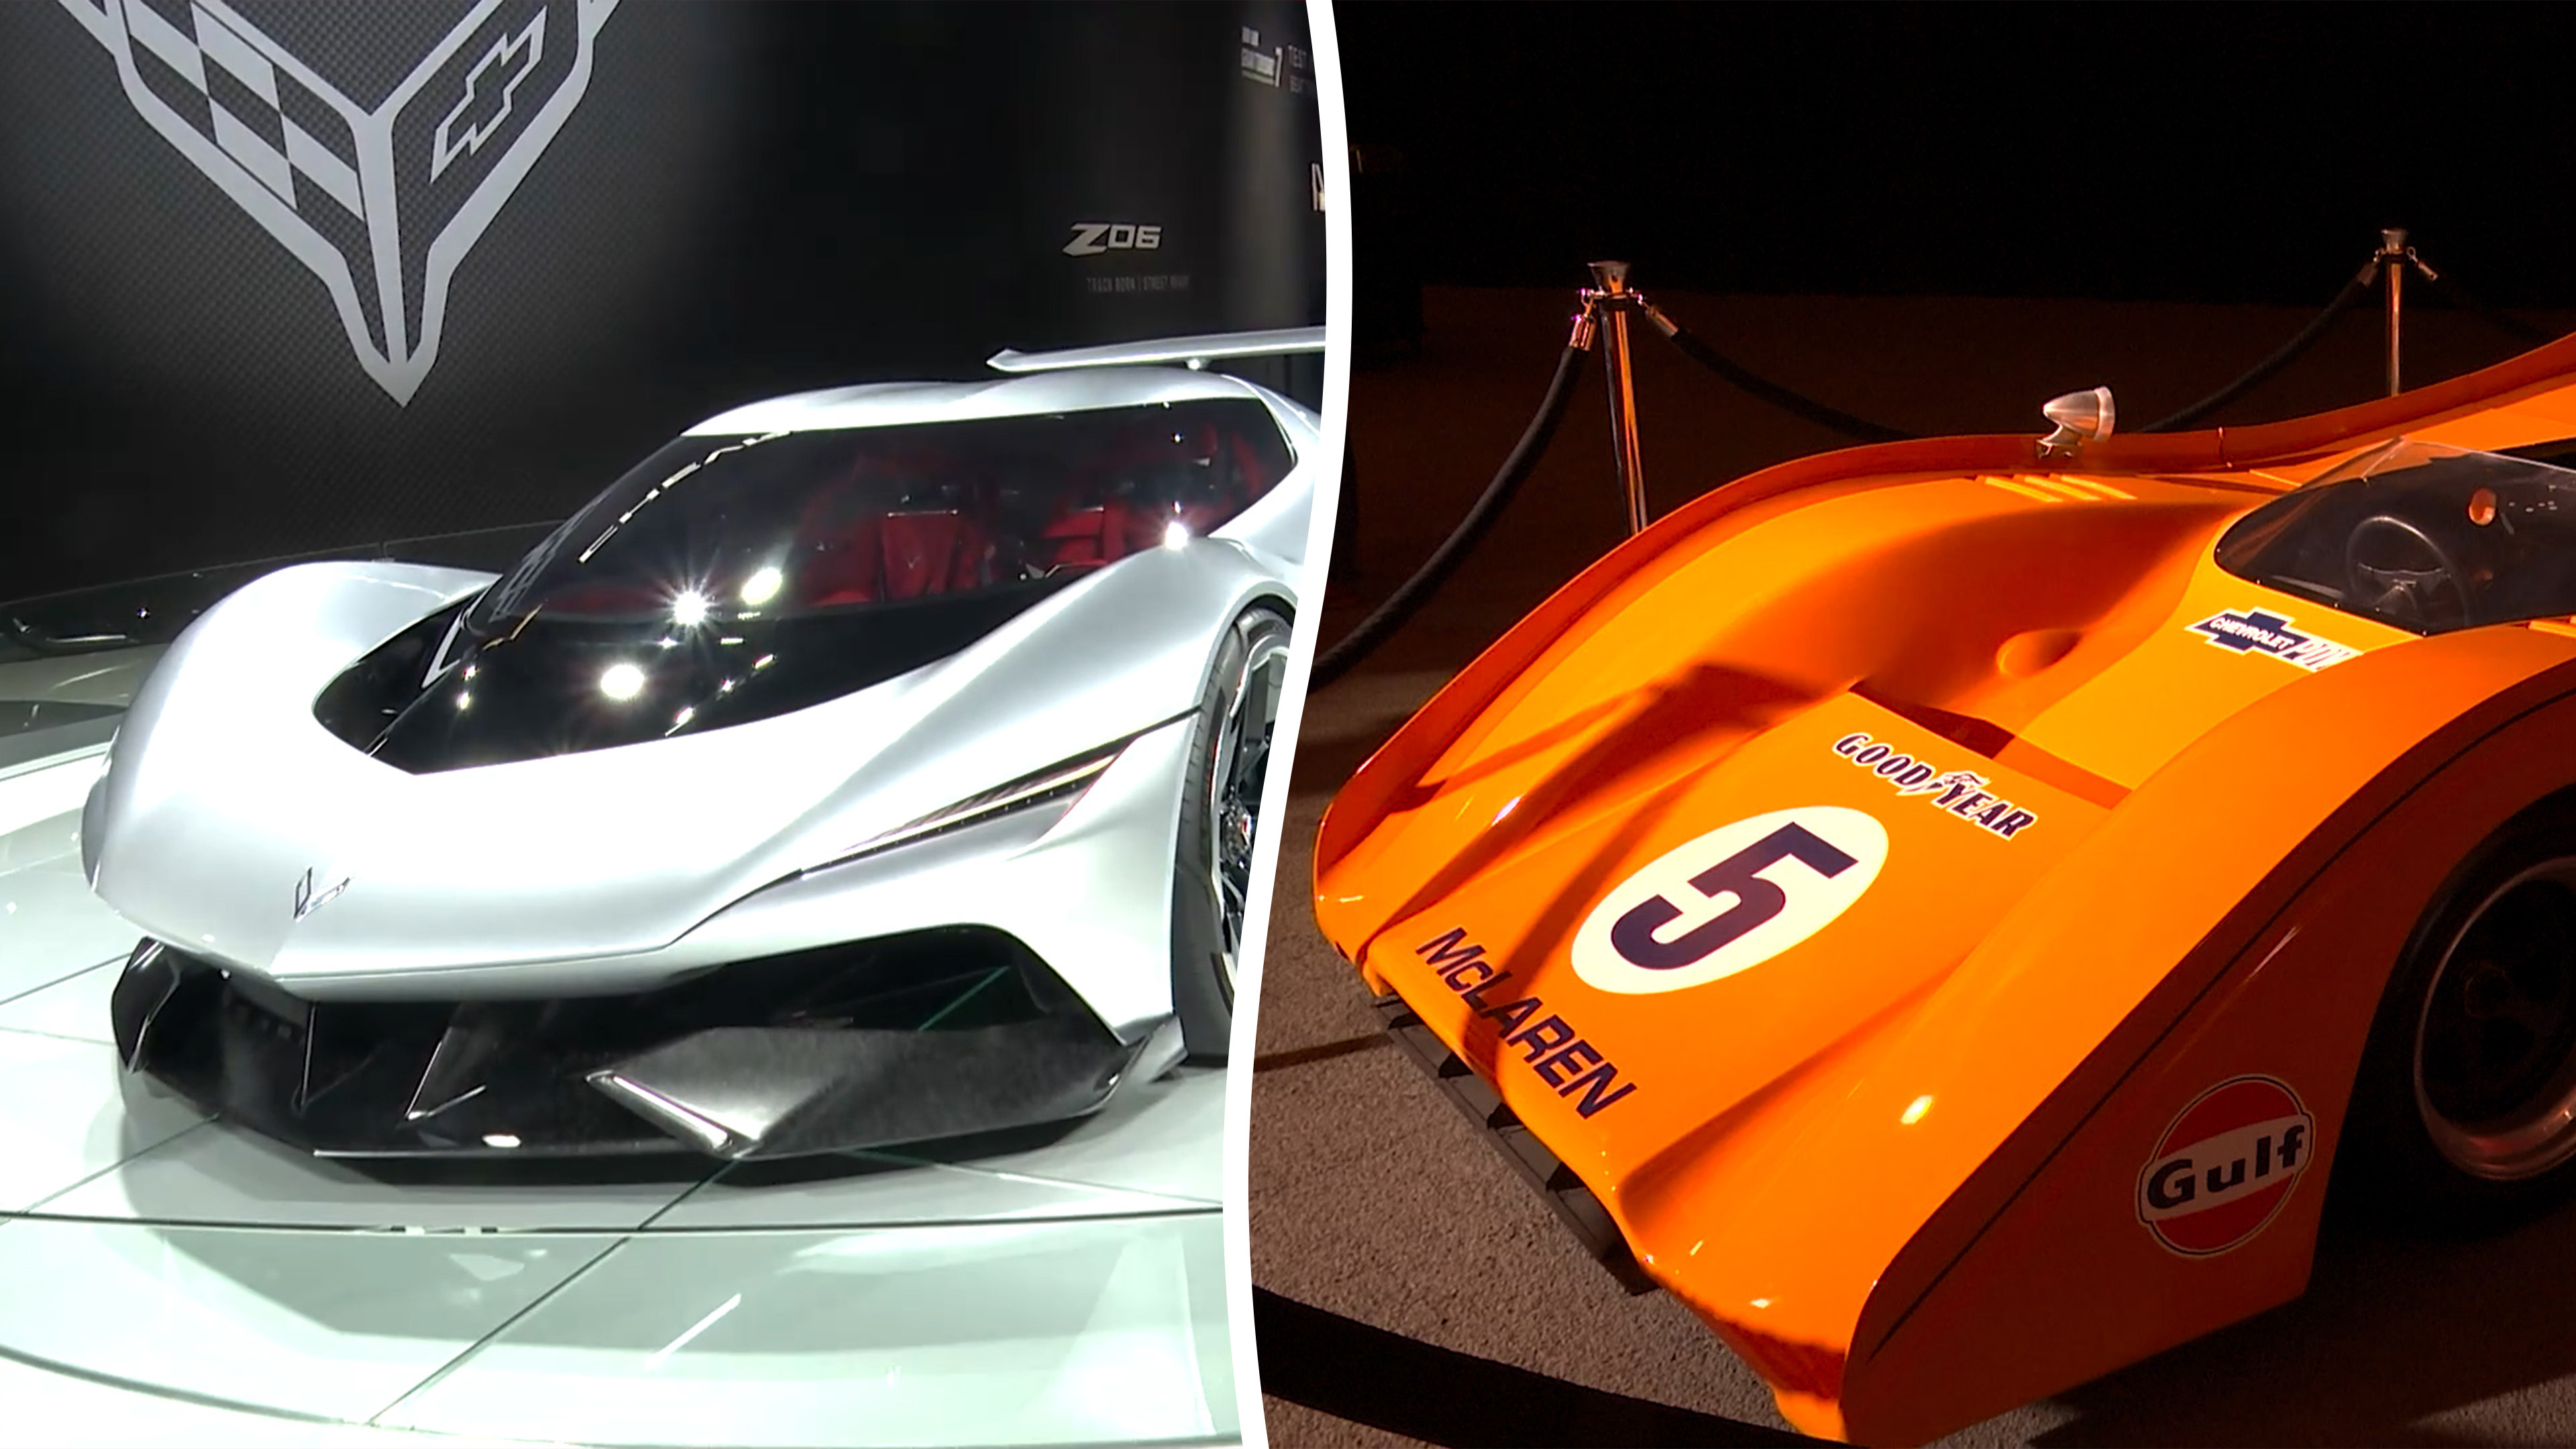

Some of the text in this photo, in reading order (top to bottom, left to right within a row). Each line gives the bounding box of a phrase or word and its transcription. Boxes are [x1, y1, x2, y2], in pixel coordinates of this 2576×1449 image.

[1063, 223, 1162, 257] Z06
[2209, 616, 2296, 651] CHEVROLET
[1611, 821, 1860, 970] 5
[1415, 926, 1638, 1120] McLAREN
[2147, 1124, 2305, 1210] Gulf
